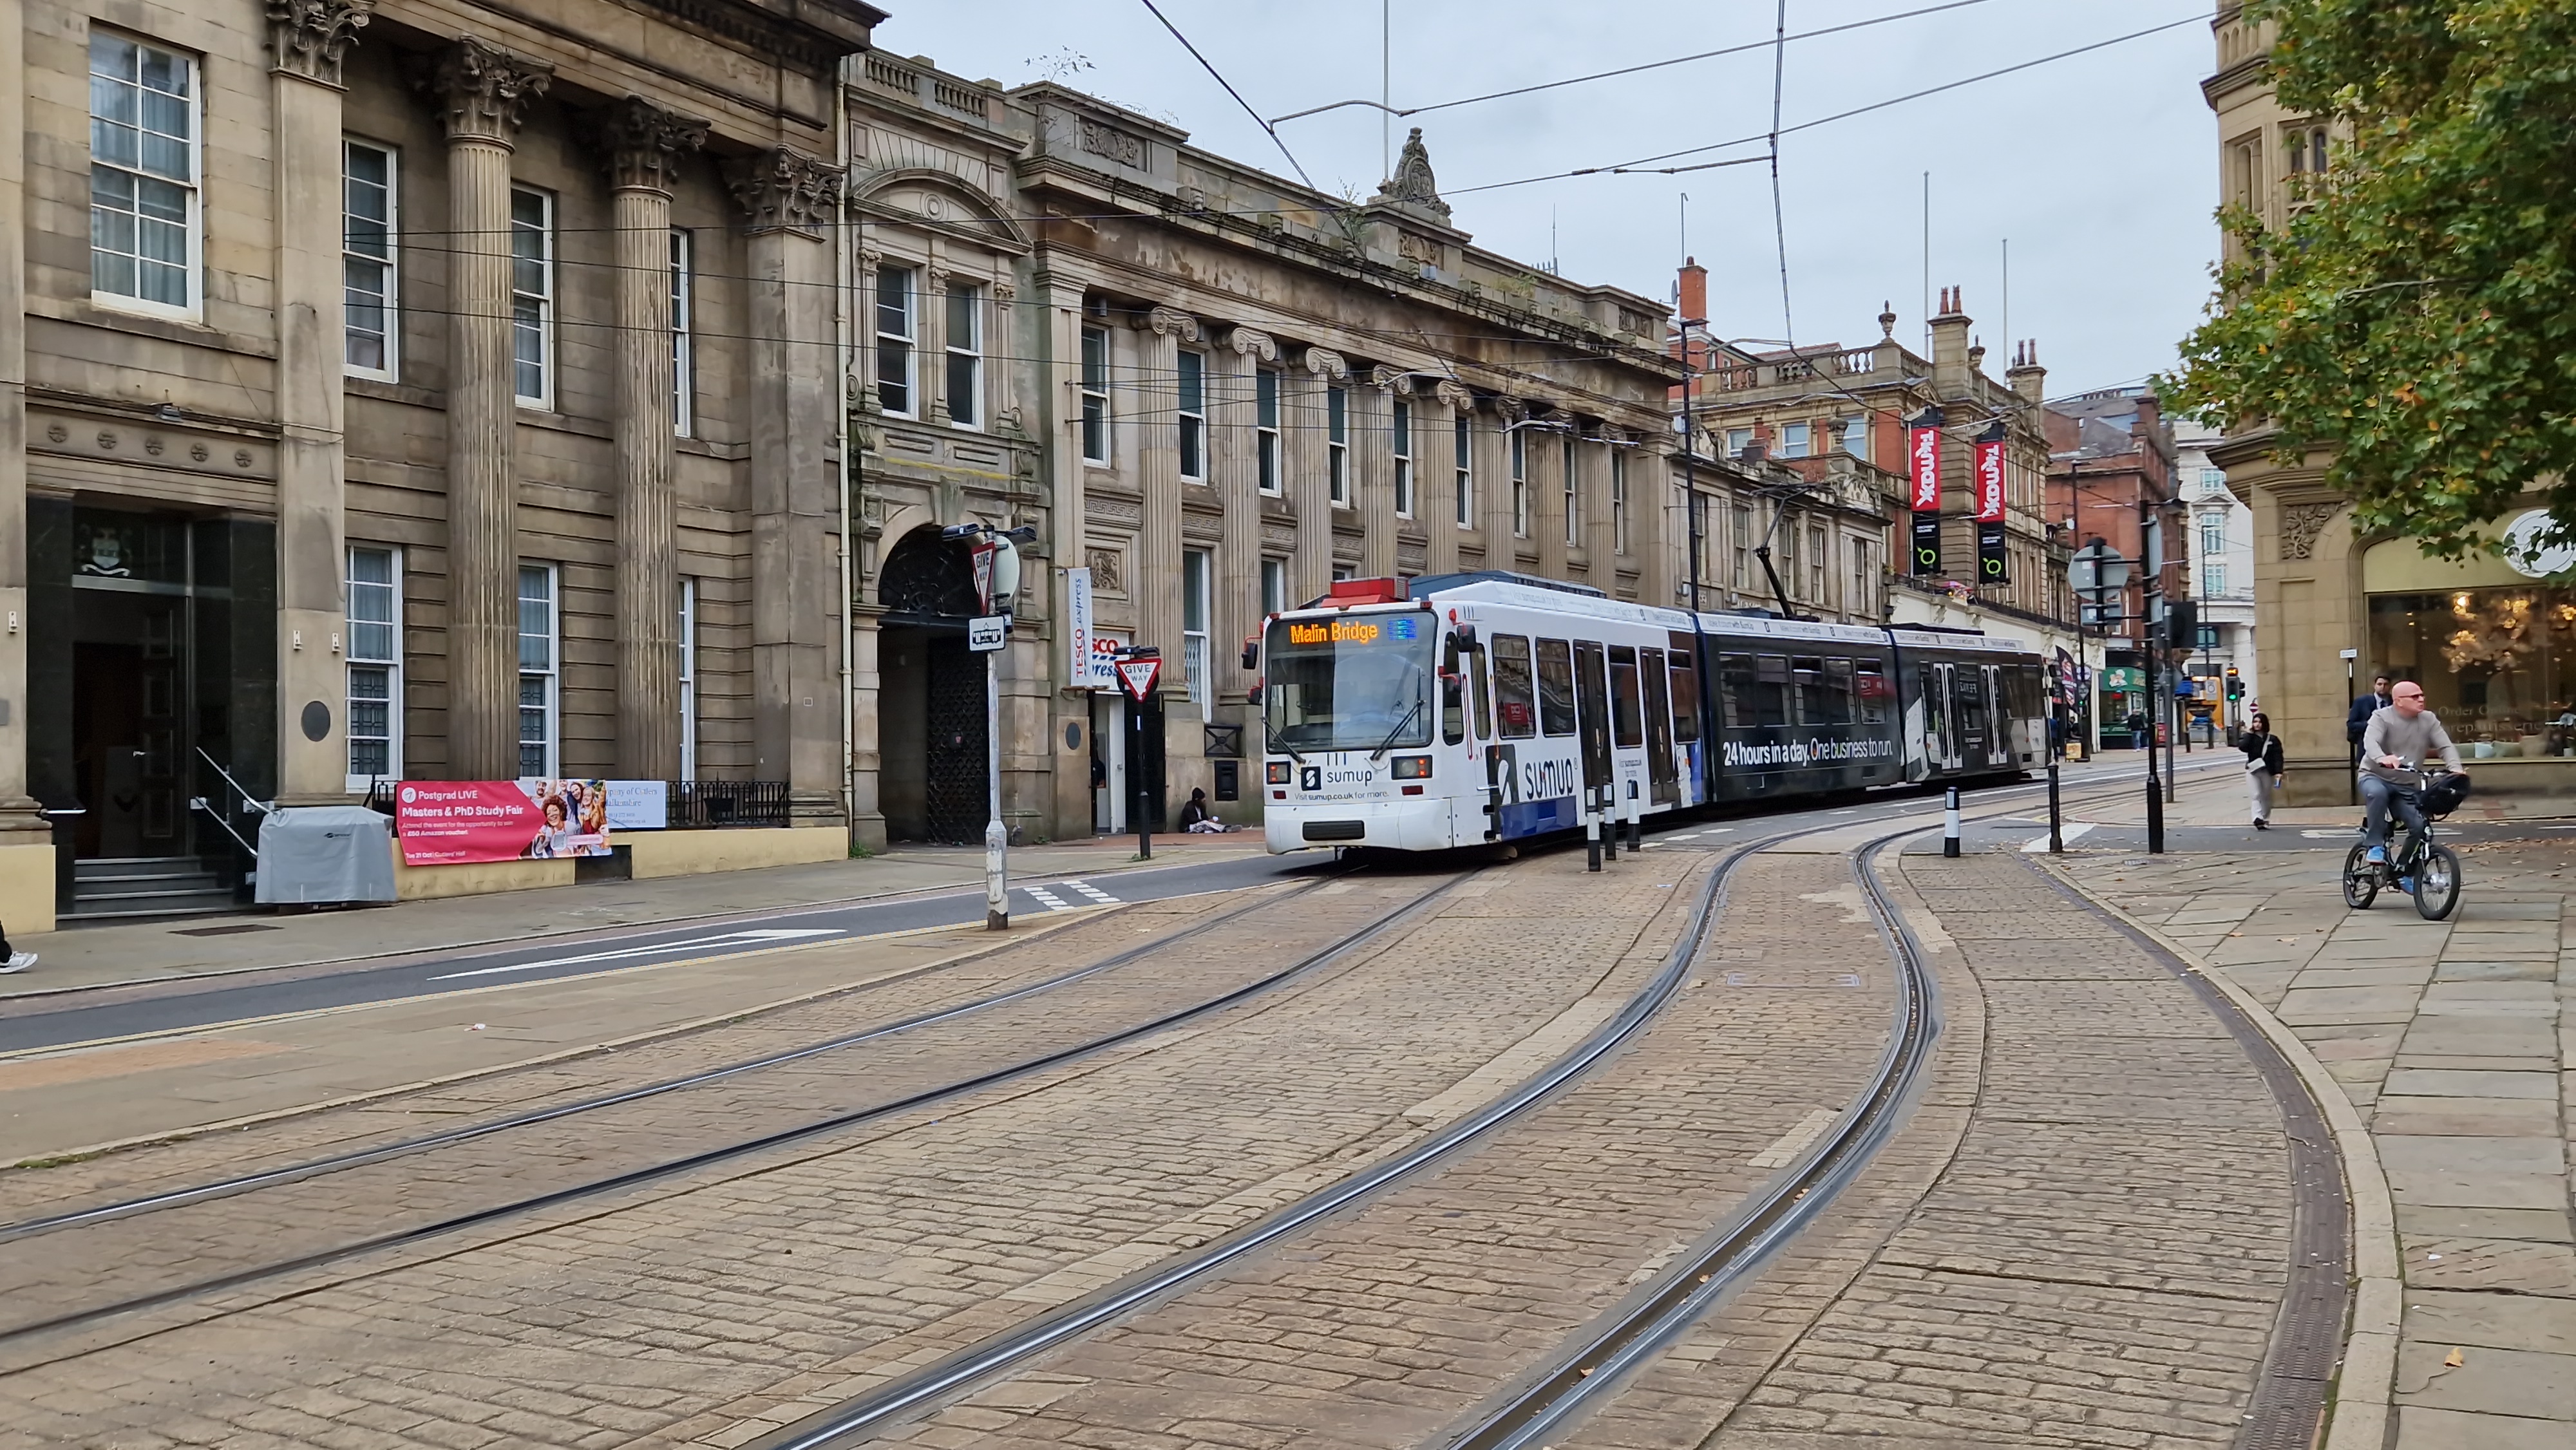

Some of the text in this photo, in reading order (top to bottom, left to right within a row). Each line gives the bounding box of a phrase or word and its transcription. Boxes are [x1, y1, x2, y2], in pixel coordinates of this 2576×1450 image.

[976, 552, 989, 568] GIVE
[1075, 578, 1084, 678] TESCO express
[1291, 621, 1378, 644] Malin Bridge
[1092, 638, 1119, 654] SCO
[1092, 664, 1119, 677] ress
[1124, 664, 1151, 674] GIVE
[2438, 706, 2472, 716] Order
[1723, 737, 1893, 767] 24 hours in a day. One business to run.
[1327, 771, 1372, 787] sumup
[1526, 757, 1573, 800] sumup
[419, 790, 478, 802] Postgrad LIVE
[607, 789, 624, 797] pany
[1309, 792, 1353, 802] sumup.co.uk
[402, 805, 523, 817] Masters & PhD Study Fair
